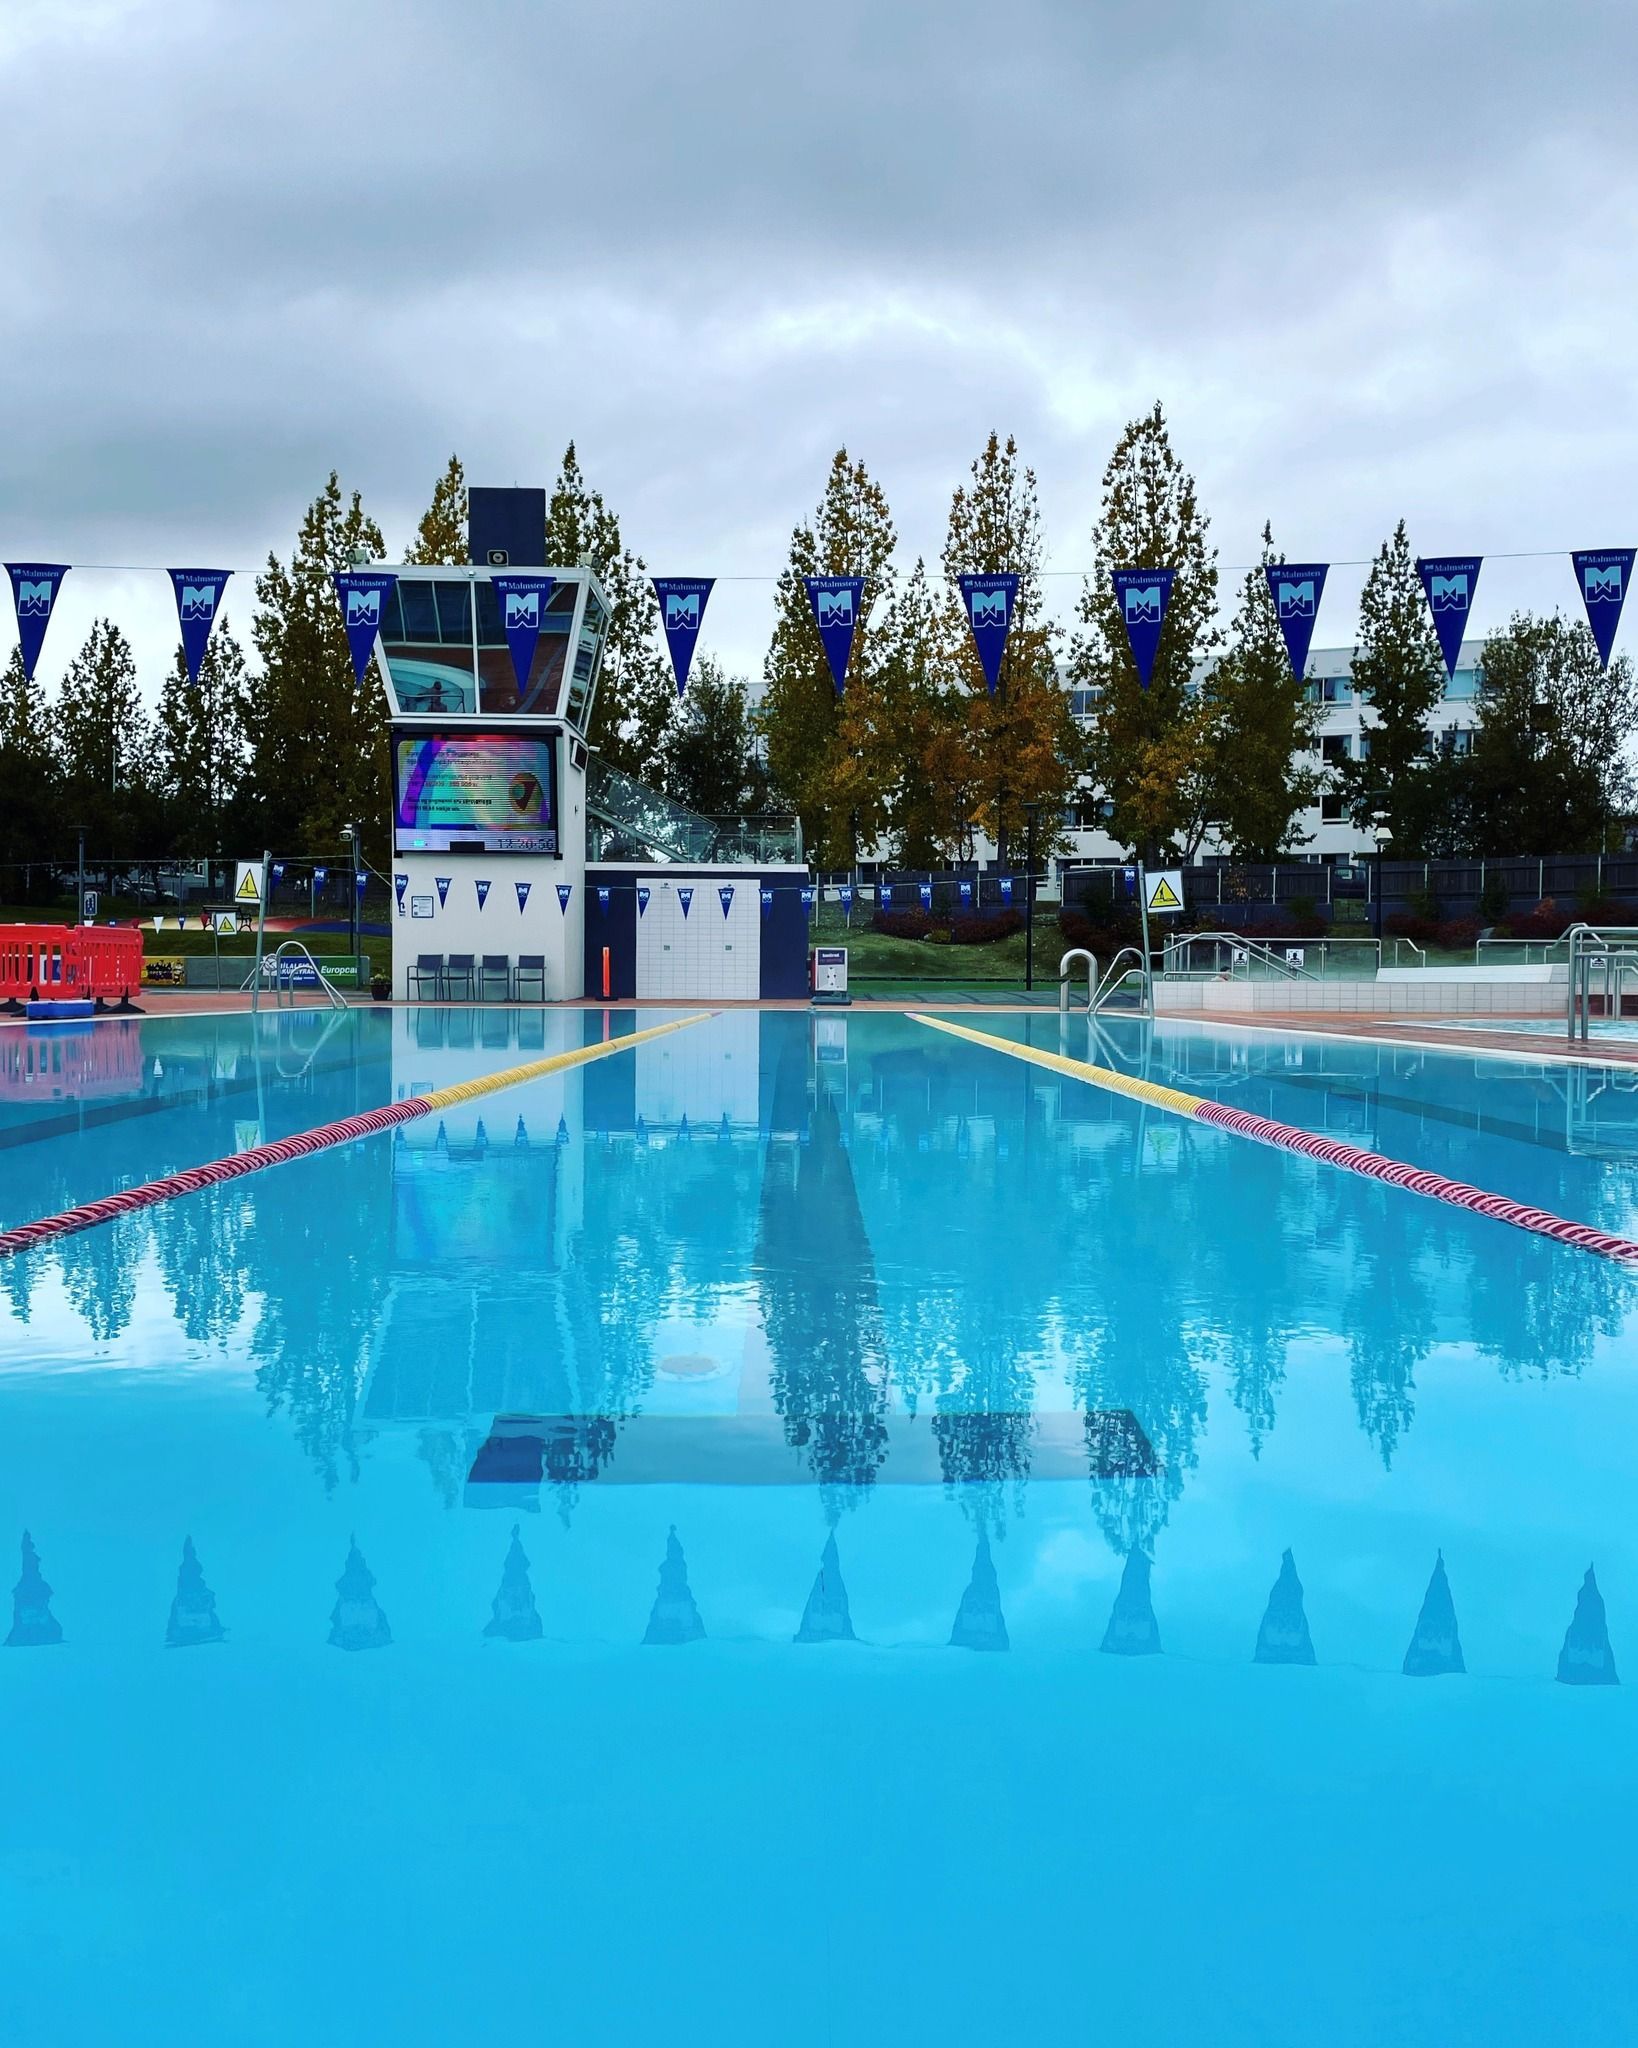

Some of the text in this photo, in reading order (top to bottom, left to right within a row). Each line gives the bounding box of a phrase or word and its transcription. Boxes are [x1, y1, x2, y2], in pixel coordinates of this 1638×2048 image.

[1435, 564, 1474, 572] Malmsten
[1282, 571, 1320, 579] Malmsten
[350, 579, 387, 587] Malmsten
[974, 580, 1012, 588] Malmsten
[1128, 576, 1167, 584] Malmsten
[508, 581, 545, 589] Malmsten
[669, 582, 706, 590] Malmsten
